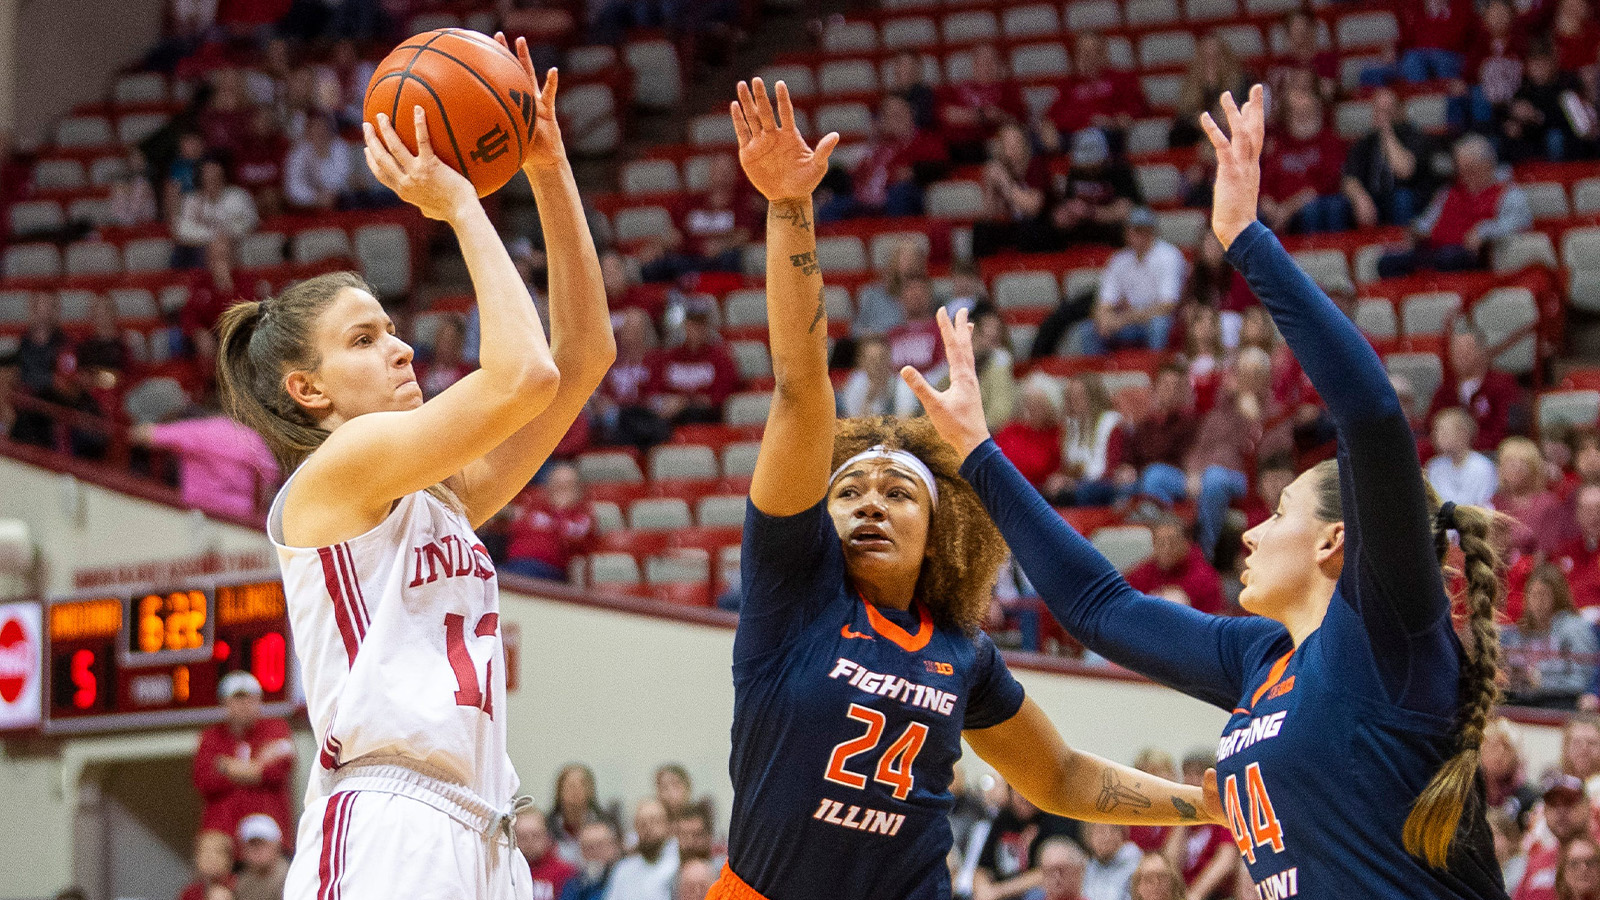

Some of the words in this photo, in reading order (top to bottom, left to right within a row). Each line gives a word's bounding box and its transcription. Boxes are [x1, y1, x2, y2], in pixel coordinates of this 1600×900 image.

[71, 650, 97, 710] 5
[829, 657, 957, 716] FIGHTING
[824, 702, 930, 801] 24
[813, 798, 906, 837] ILLINI
[1224, 761, 1286, 865] 44
